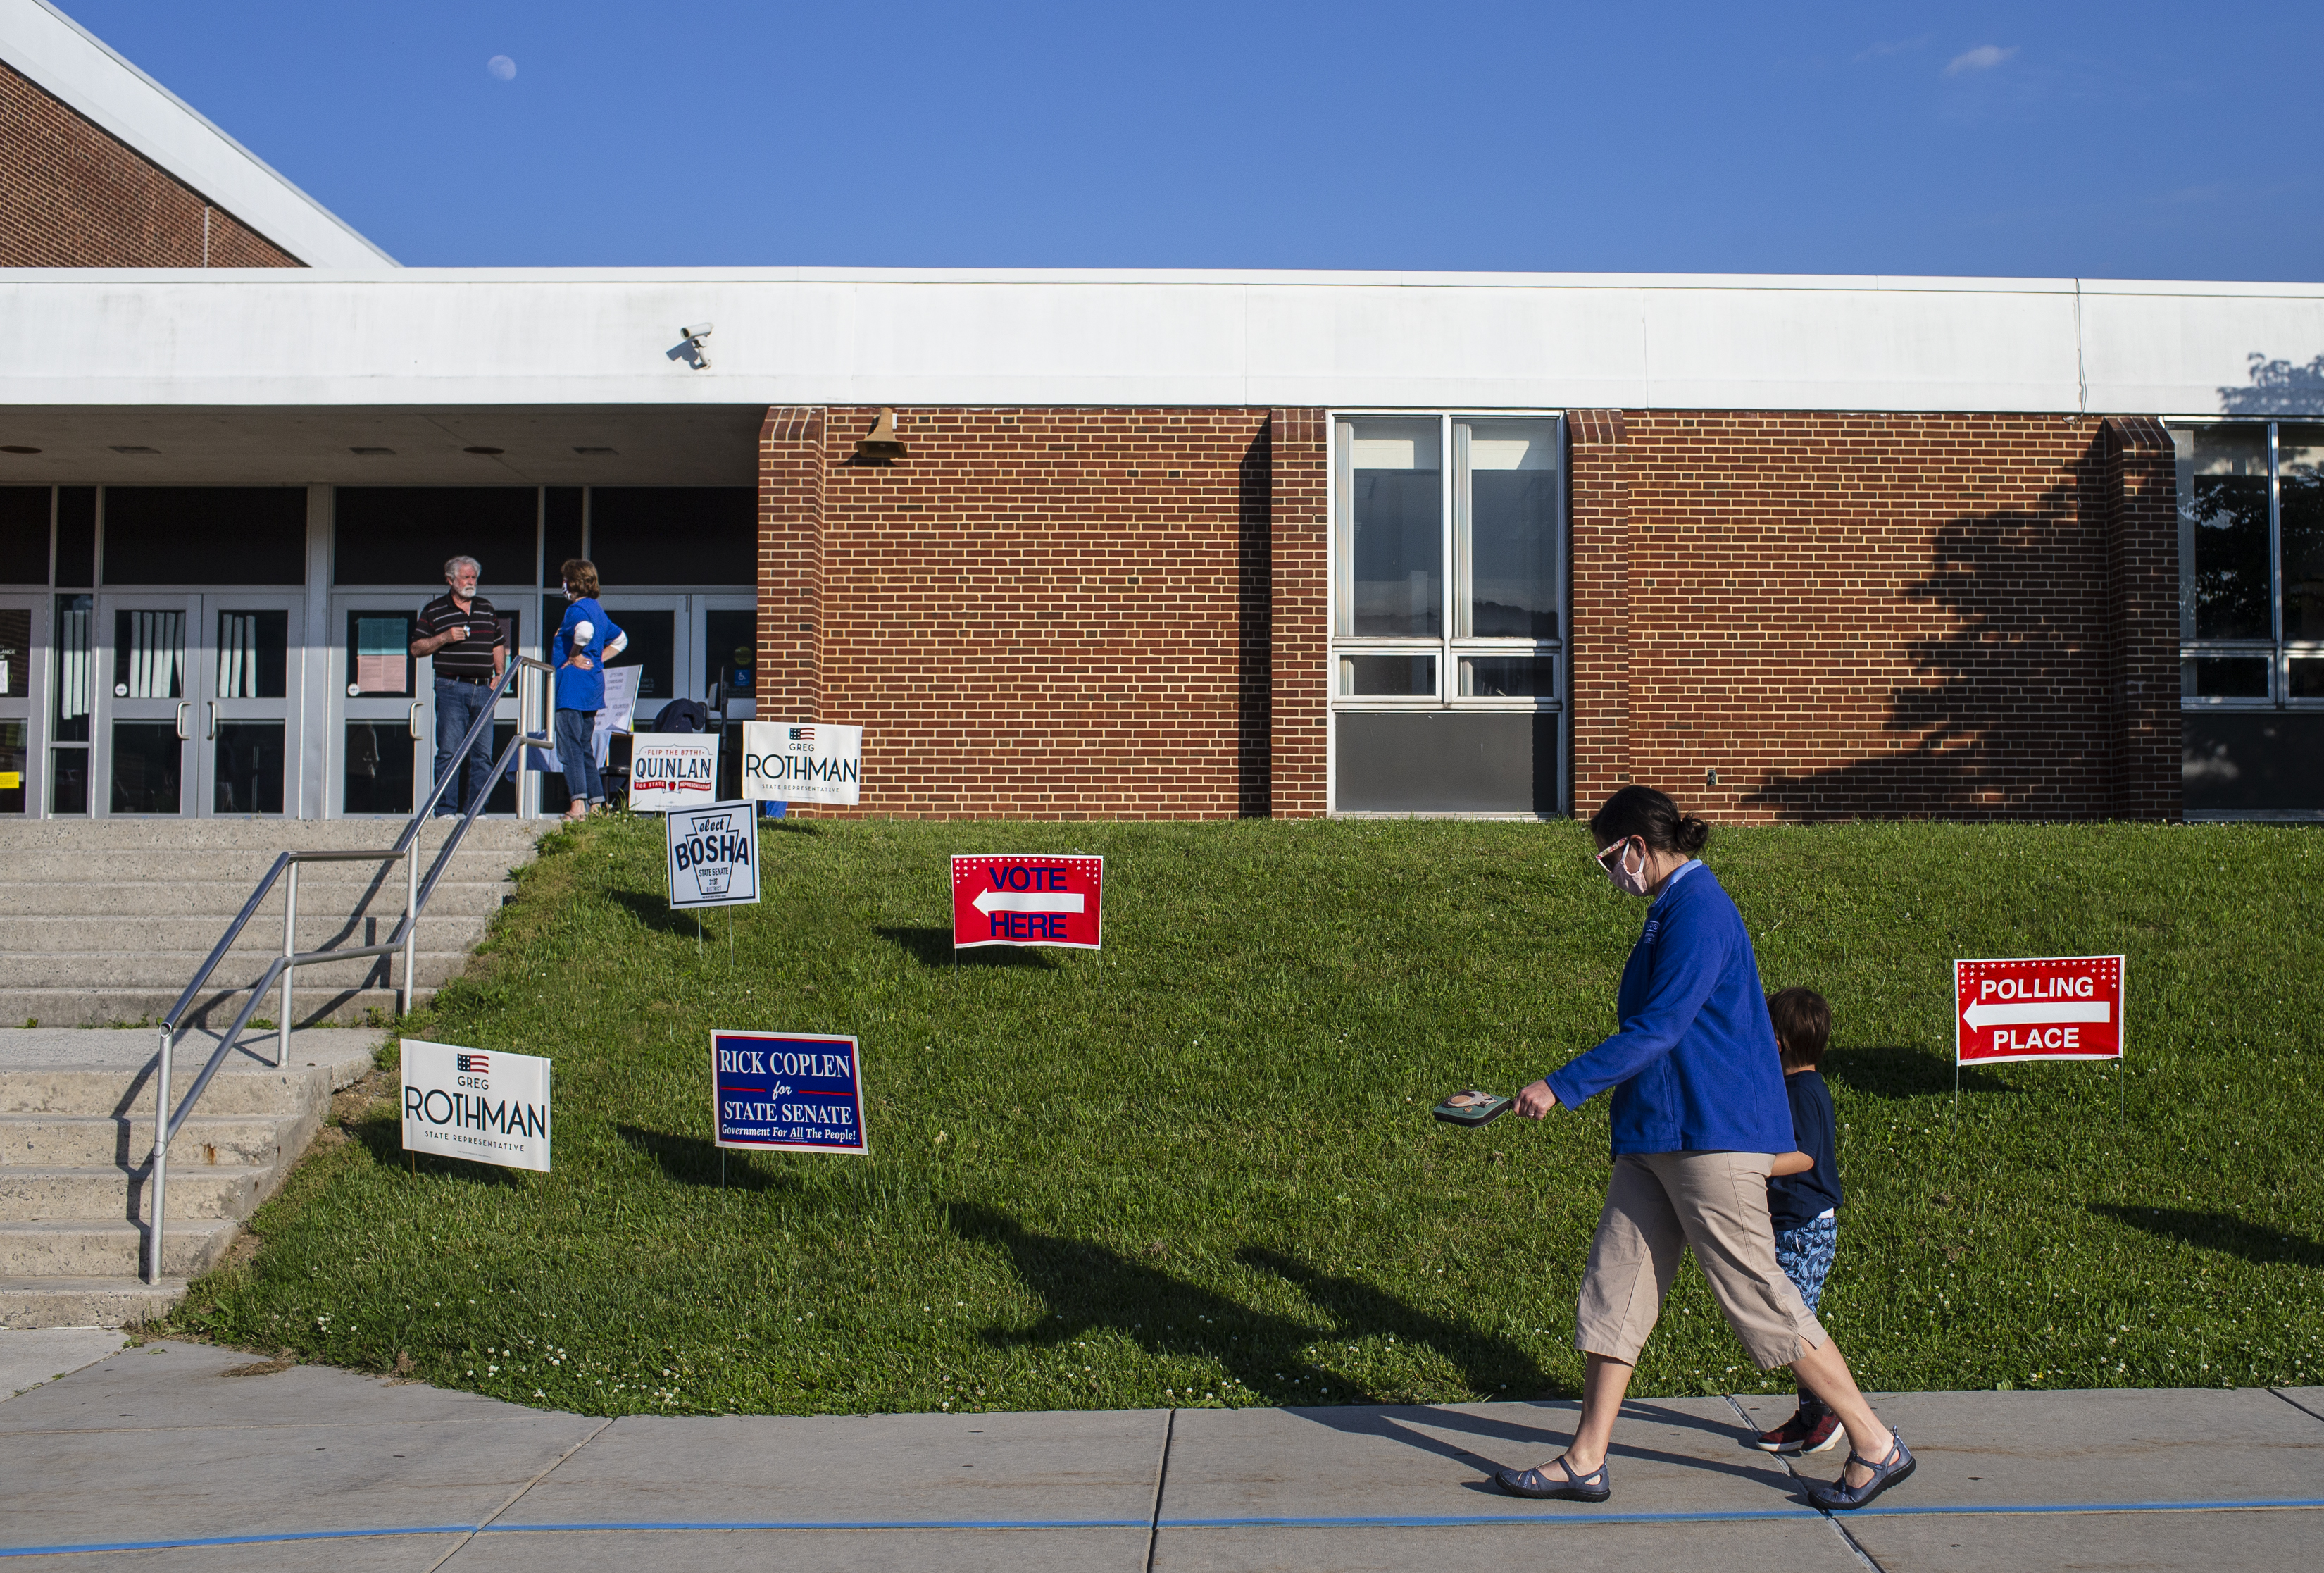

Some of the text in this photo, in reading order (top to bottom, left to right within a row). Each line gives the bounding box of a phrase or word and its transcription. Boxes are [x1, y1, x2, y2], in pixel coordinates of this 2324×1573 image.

[789, 743, 815, 752] GREG
[635, 757, 712, 779] QUINLAN
[746, 754, 858, 783] ROTHMAN
[783, 784, 839, 793] REPRESENTATIVE
[699, 817, 725, 833] elect
[675, 835, 749, 871] BOSHA
[699, 867, 729, 877] STATE SENATE
[989, 866, 1068, 891] VOTE
[990, 913, 1068, 939] HERE
[1980, 976, 2094, 1000] POLLING
[1994, 1028, 2080, 1051] PLACE
[719, 1050, 850, 1078] RICK COPLEN
[458, 1076, 489, 1090] GREG
[773, 1080, 792, 1100] for
[405, 1086, 546, 1139] ROTHMAN
[725, 1101, 853, 1125] STATE SENATE
[425, 1131, 525, 1152] STATE REPRESENTATIVE
[722, 1124, 856, 1143] Government For All The People!
